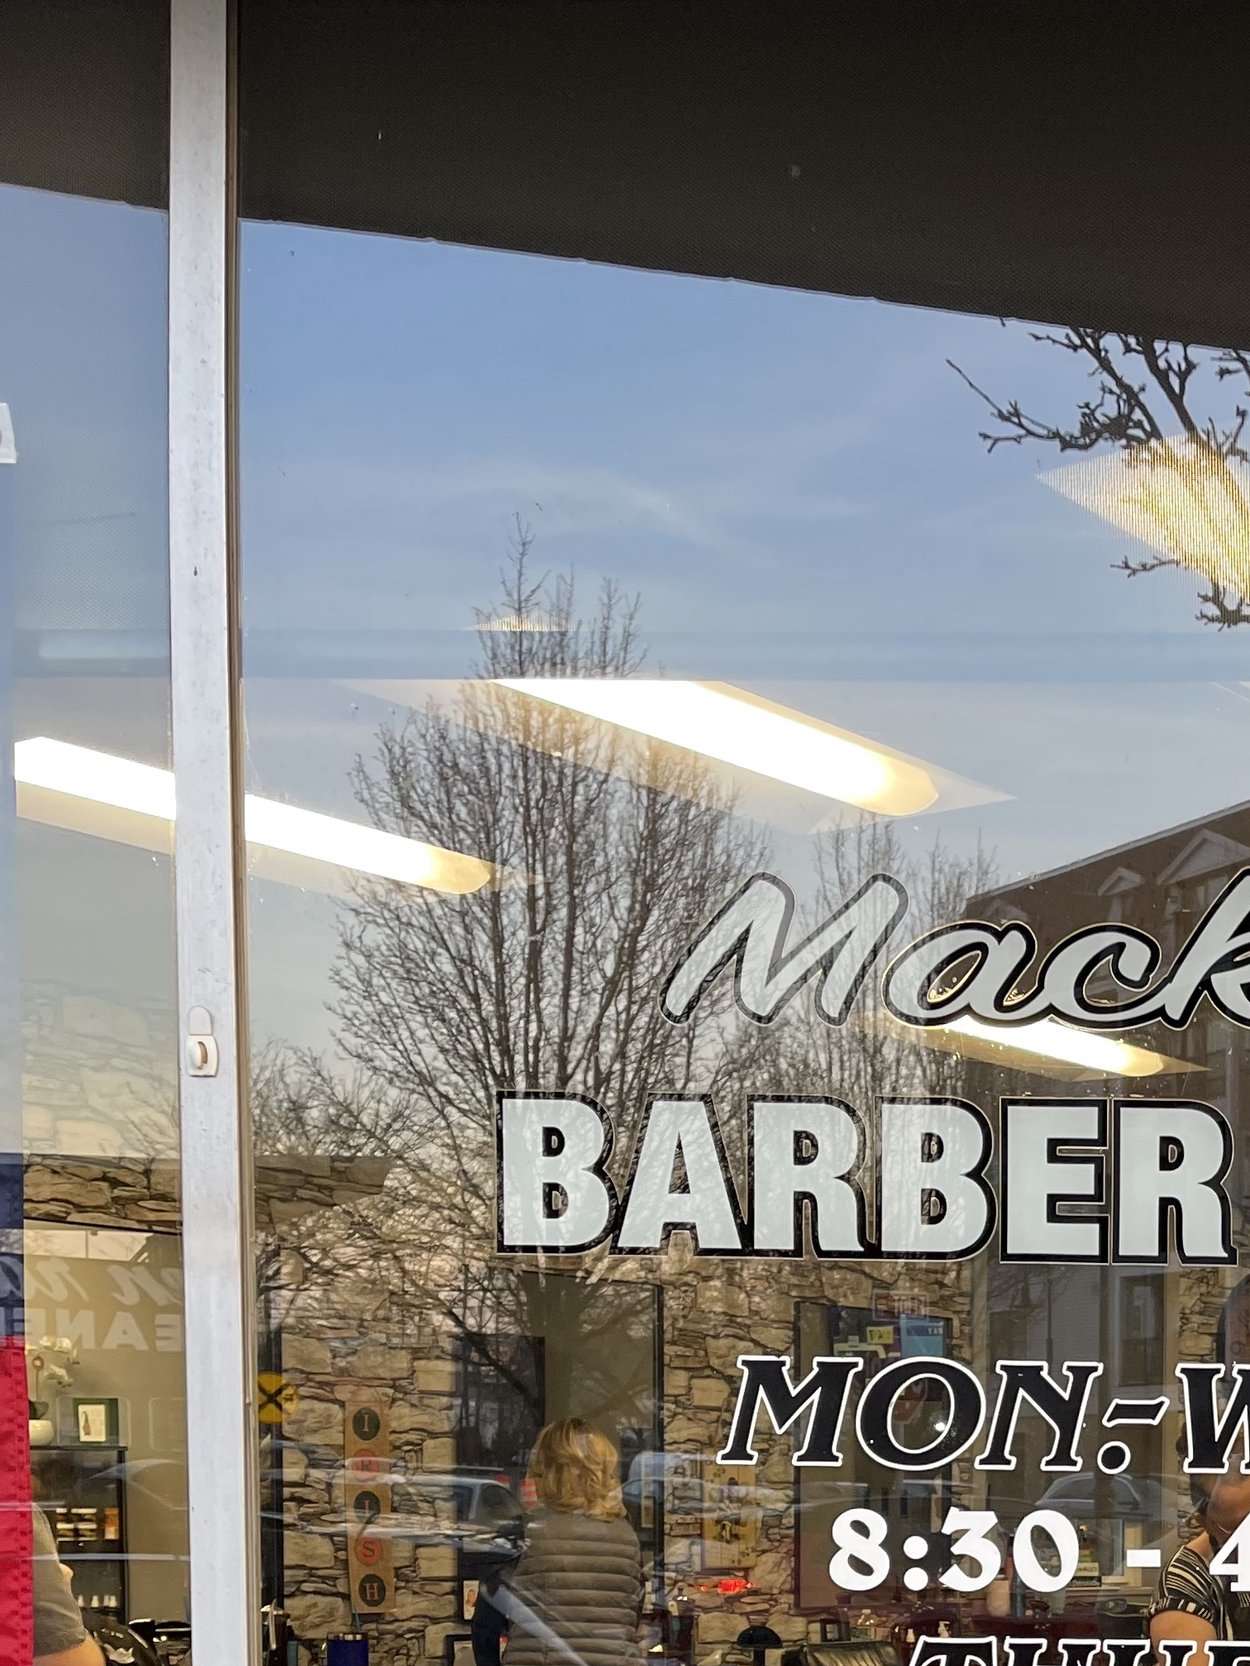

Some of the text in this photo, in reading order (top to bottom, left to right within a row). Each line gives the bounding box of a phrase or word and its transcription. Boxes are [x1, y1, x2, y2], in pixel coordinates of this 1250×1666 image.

[497, 1091, 1238, 1268] BARBER
[829, 1508, 1081, 1592] 8:30
[1126, 1548, 1162, 1568] -
